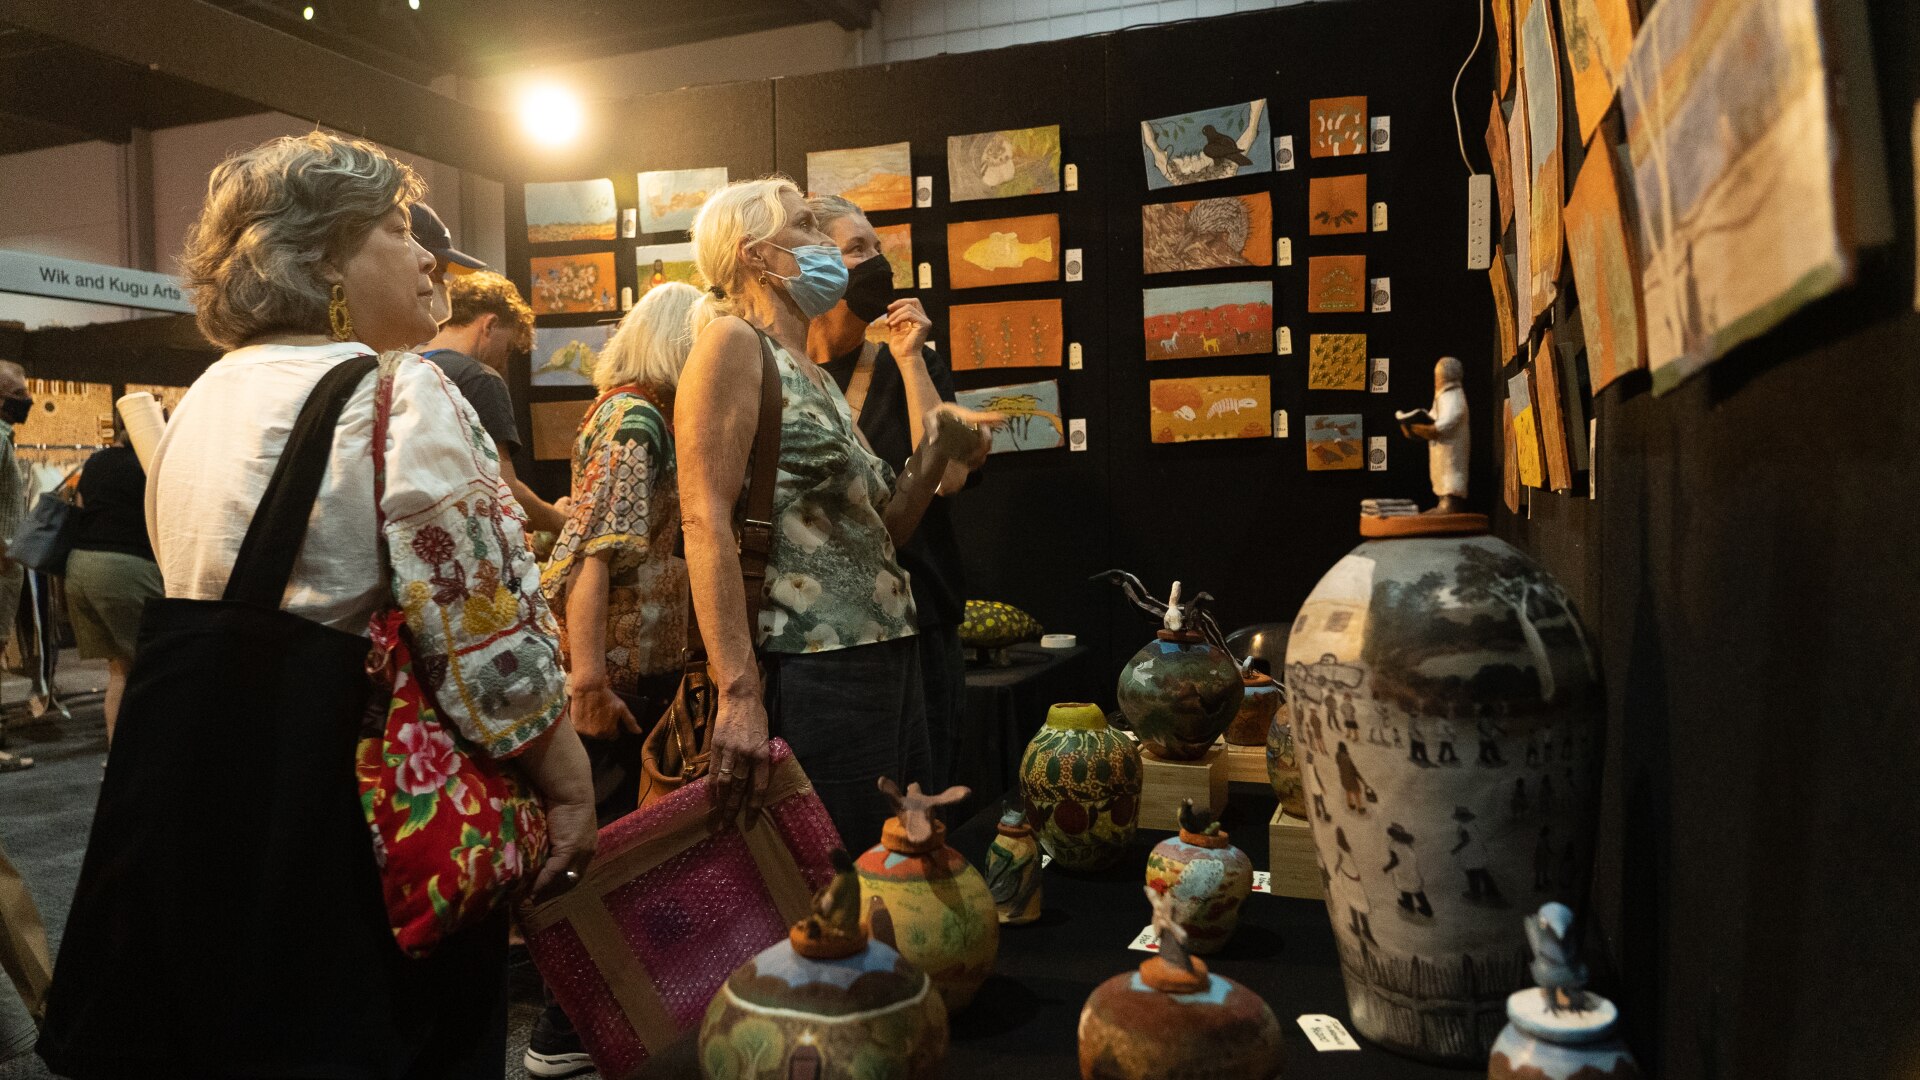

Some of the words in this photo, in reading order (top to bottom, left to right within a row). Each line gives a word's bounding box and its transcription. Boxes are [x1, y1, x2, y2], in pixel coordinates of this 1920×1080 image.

[39, 266, 70, 285] Wik
[75, 275, 104, 289] and
[109, 276, 148, 298] Kugu
[153, 283, 181, 300] Arts
